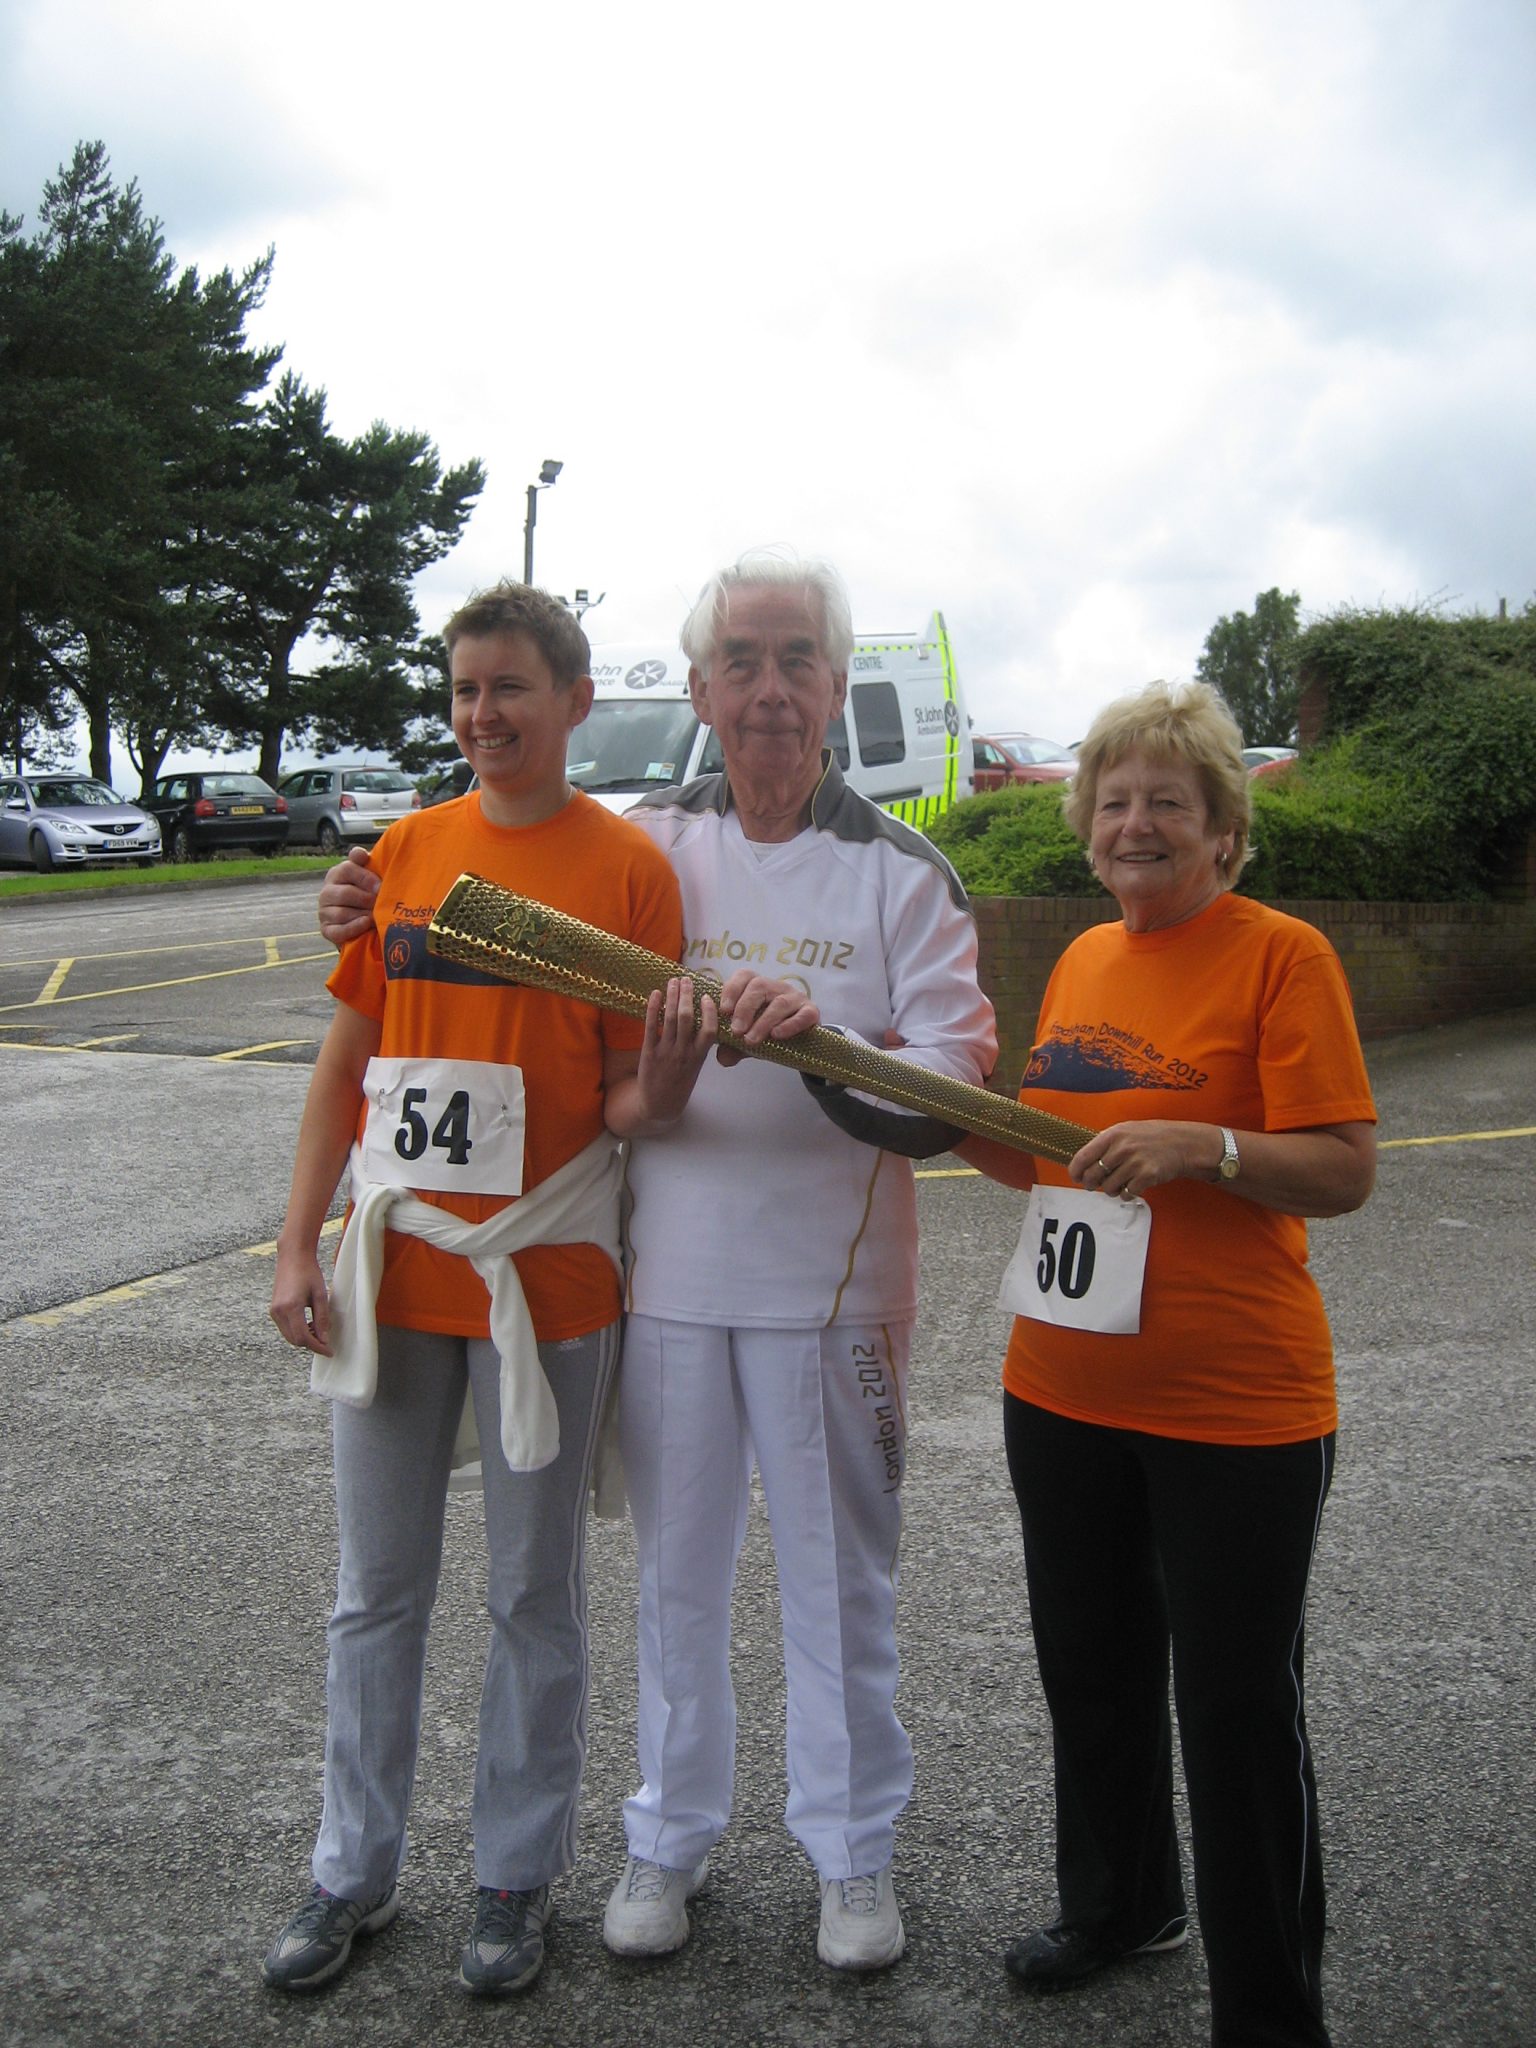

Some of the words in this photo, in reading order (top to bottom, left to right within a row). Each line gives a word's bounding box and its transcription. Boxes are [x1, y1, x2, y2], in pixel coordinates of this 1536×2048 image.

[853, 655, 883, 671] CENTRE
[914, 706, 925, 724] St
[925, 705, 945, 722] John
[683, 930, 768, 963] ndon
[776, 936, 855, 970] 2012
[1099, 1022, 1145, 1049] Downhill
[1142, 1043, 1166, 1064] Run
[1167, 1057, 1208, 1088] 2012
[395, 1088, 472, 1165] 54
[1037, 1218, 1096, 1300] 50
[852, 1343, 886, 1398] 2012
